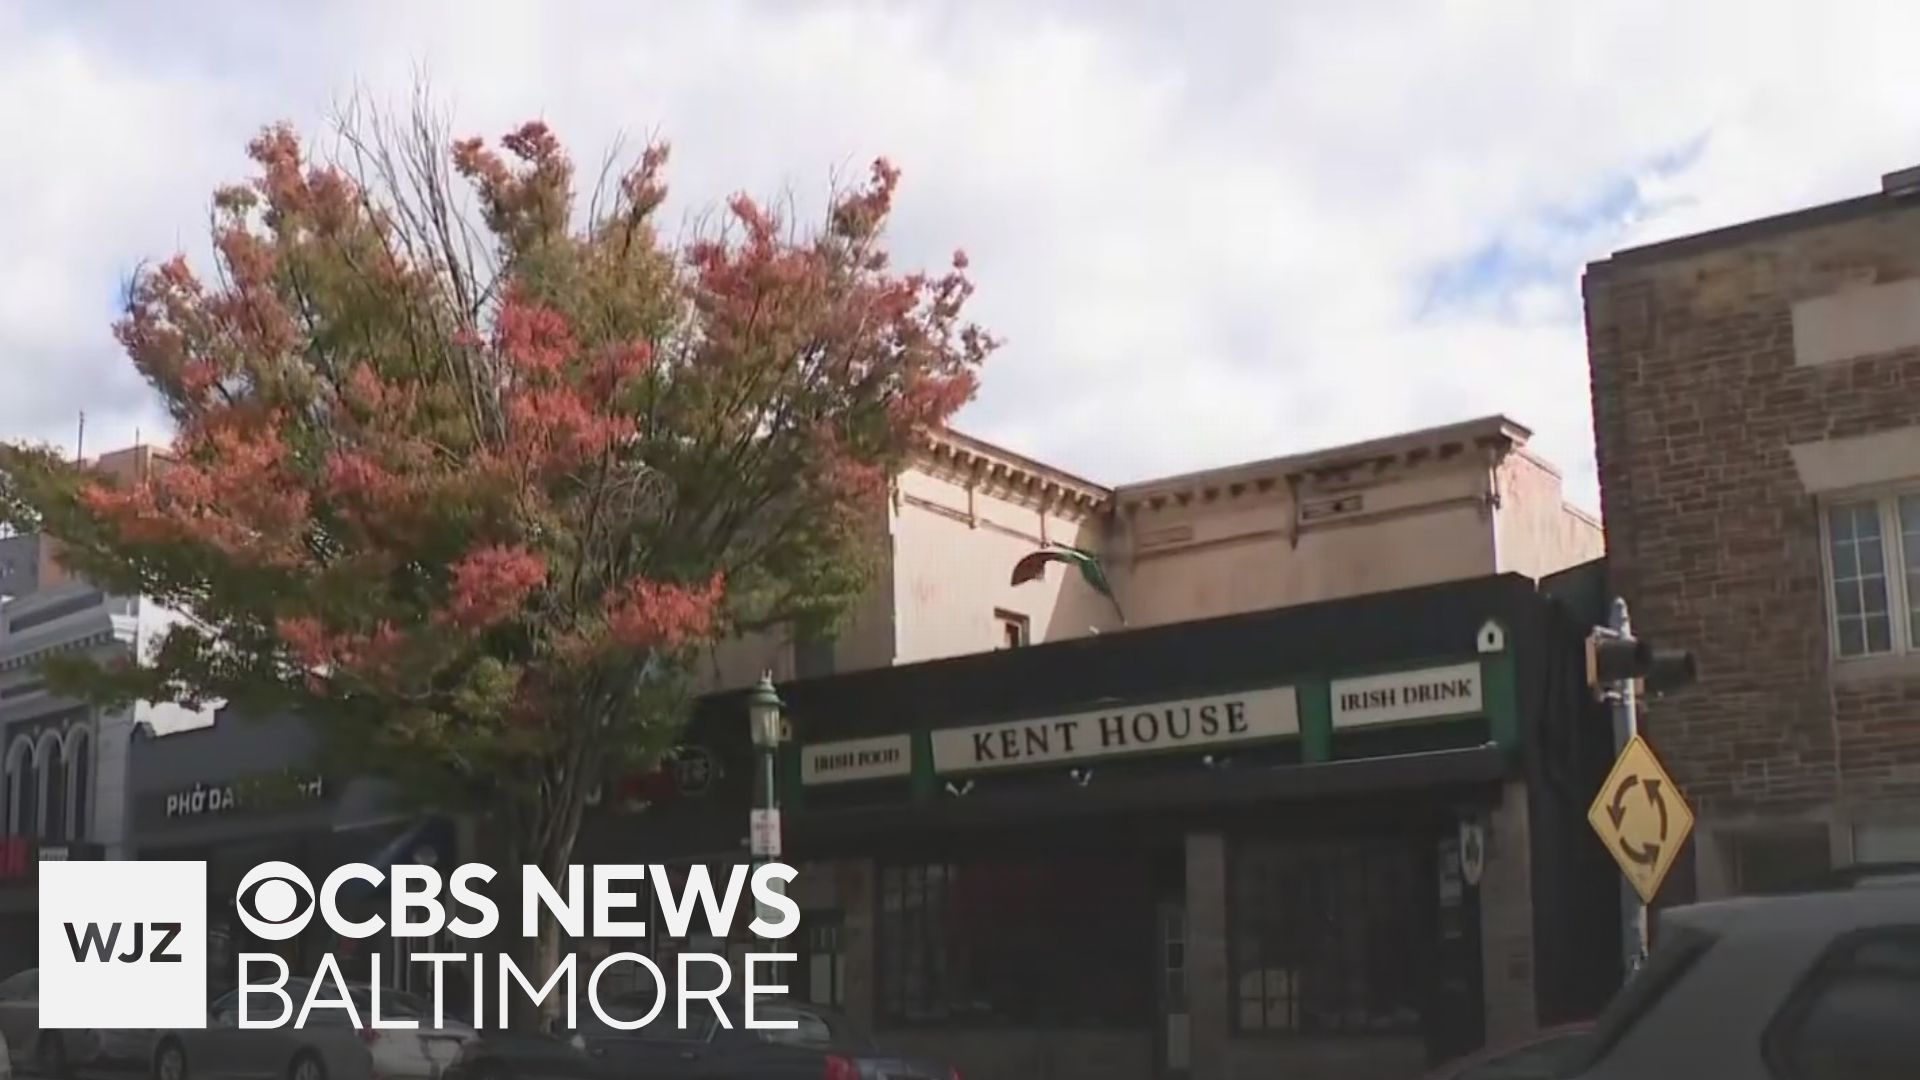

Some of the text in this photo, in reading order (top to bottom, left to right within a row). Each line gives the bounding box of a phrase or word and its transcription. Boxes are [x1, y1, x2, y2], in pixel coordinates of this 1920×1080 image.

[1340, 678, 1473, 711] IRISH DRINK
[972, 701, 1249, 762] KENT HOUSE
[814, 752, 854, 774] IRISH
